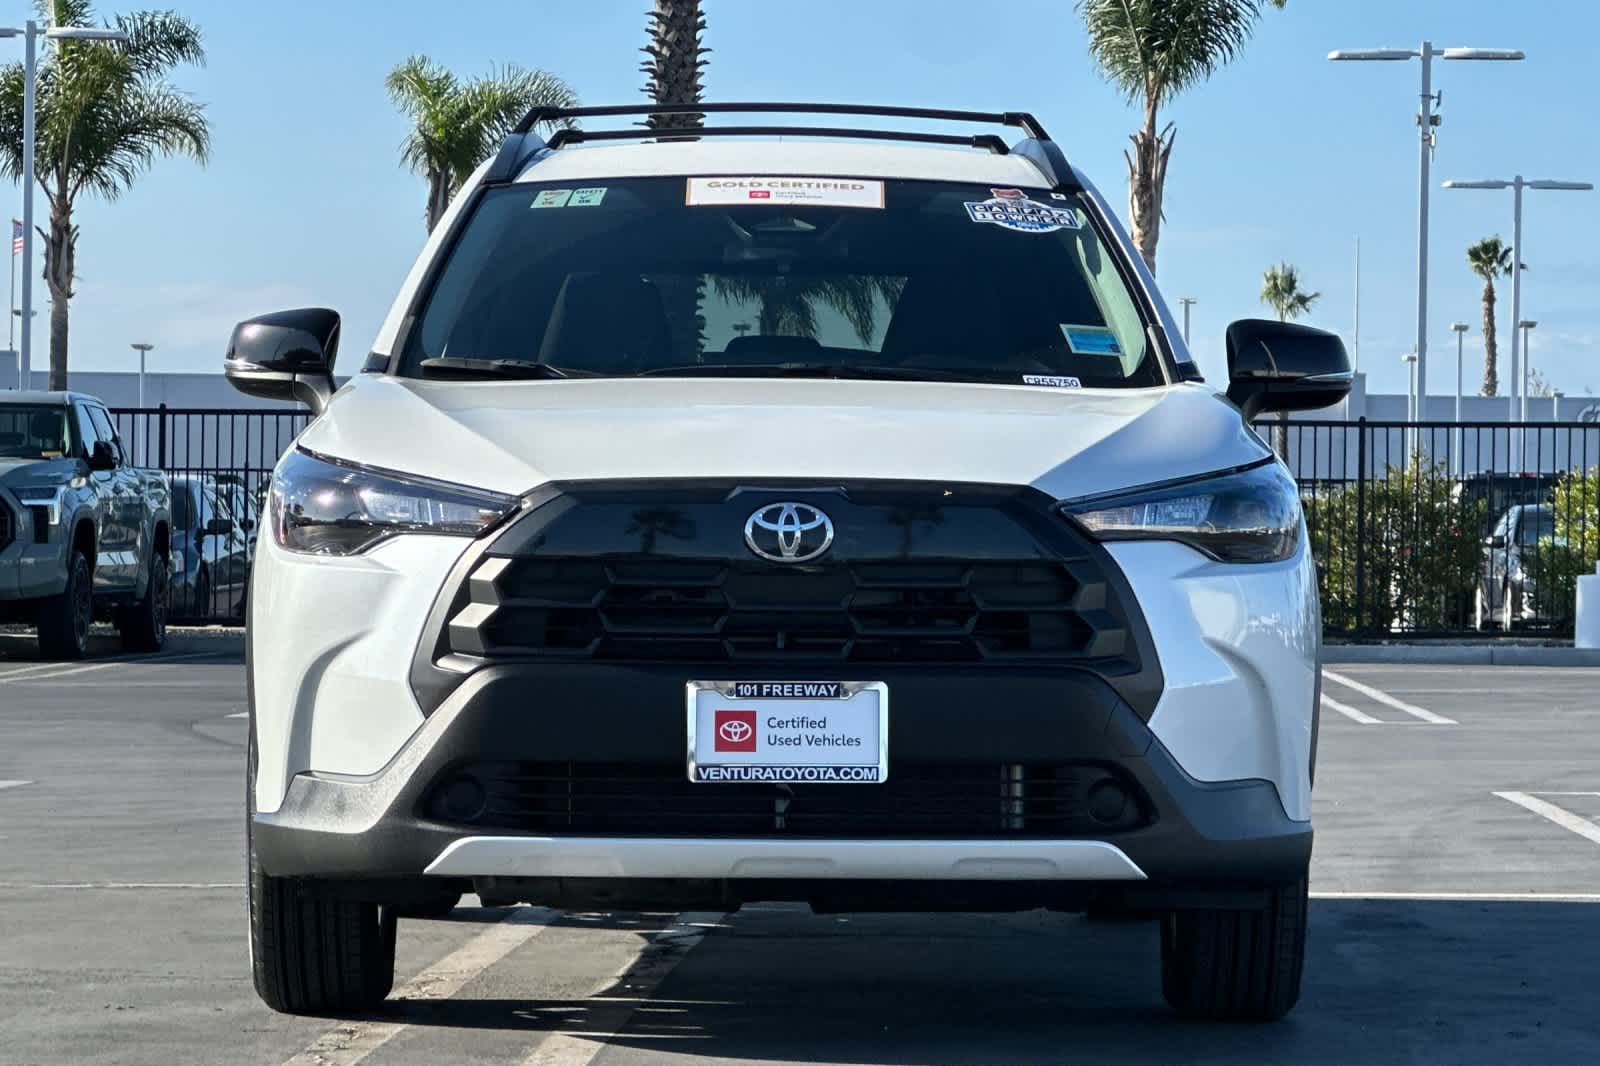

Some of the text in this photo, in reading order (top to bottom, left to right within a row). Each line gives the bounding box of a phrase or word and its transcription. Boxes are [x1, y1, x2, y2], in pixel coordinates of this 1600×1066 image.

[767, 181, 865, 190] CERTIFIED
[974, 205, 1070, 219] CARFAX
[737, 684, 838, 697] 101 FREEWAY
[767, 716, 827, 729] Certified
[767, 735, 861, 746] Used Vehicles
[698, 767, 877, 780] VENTURATOYOTA.COM
